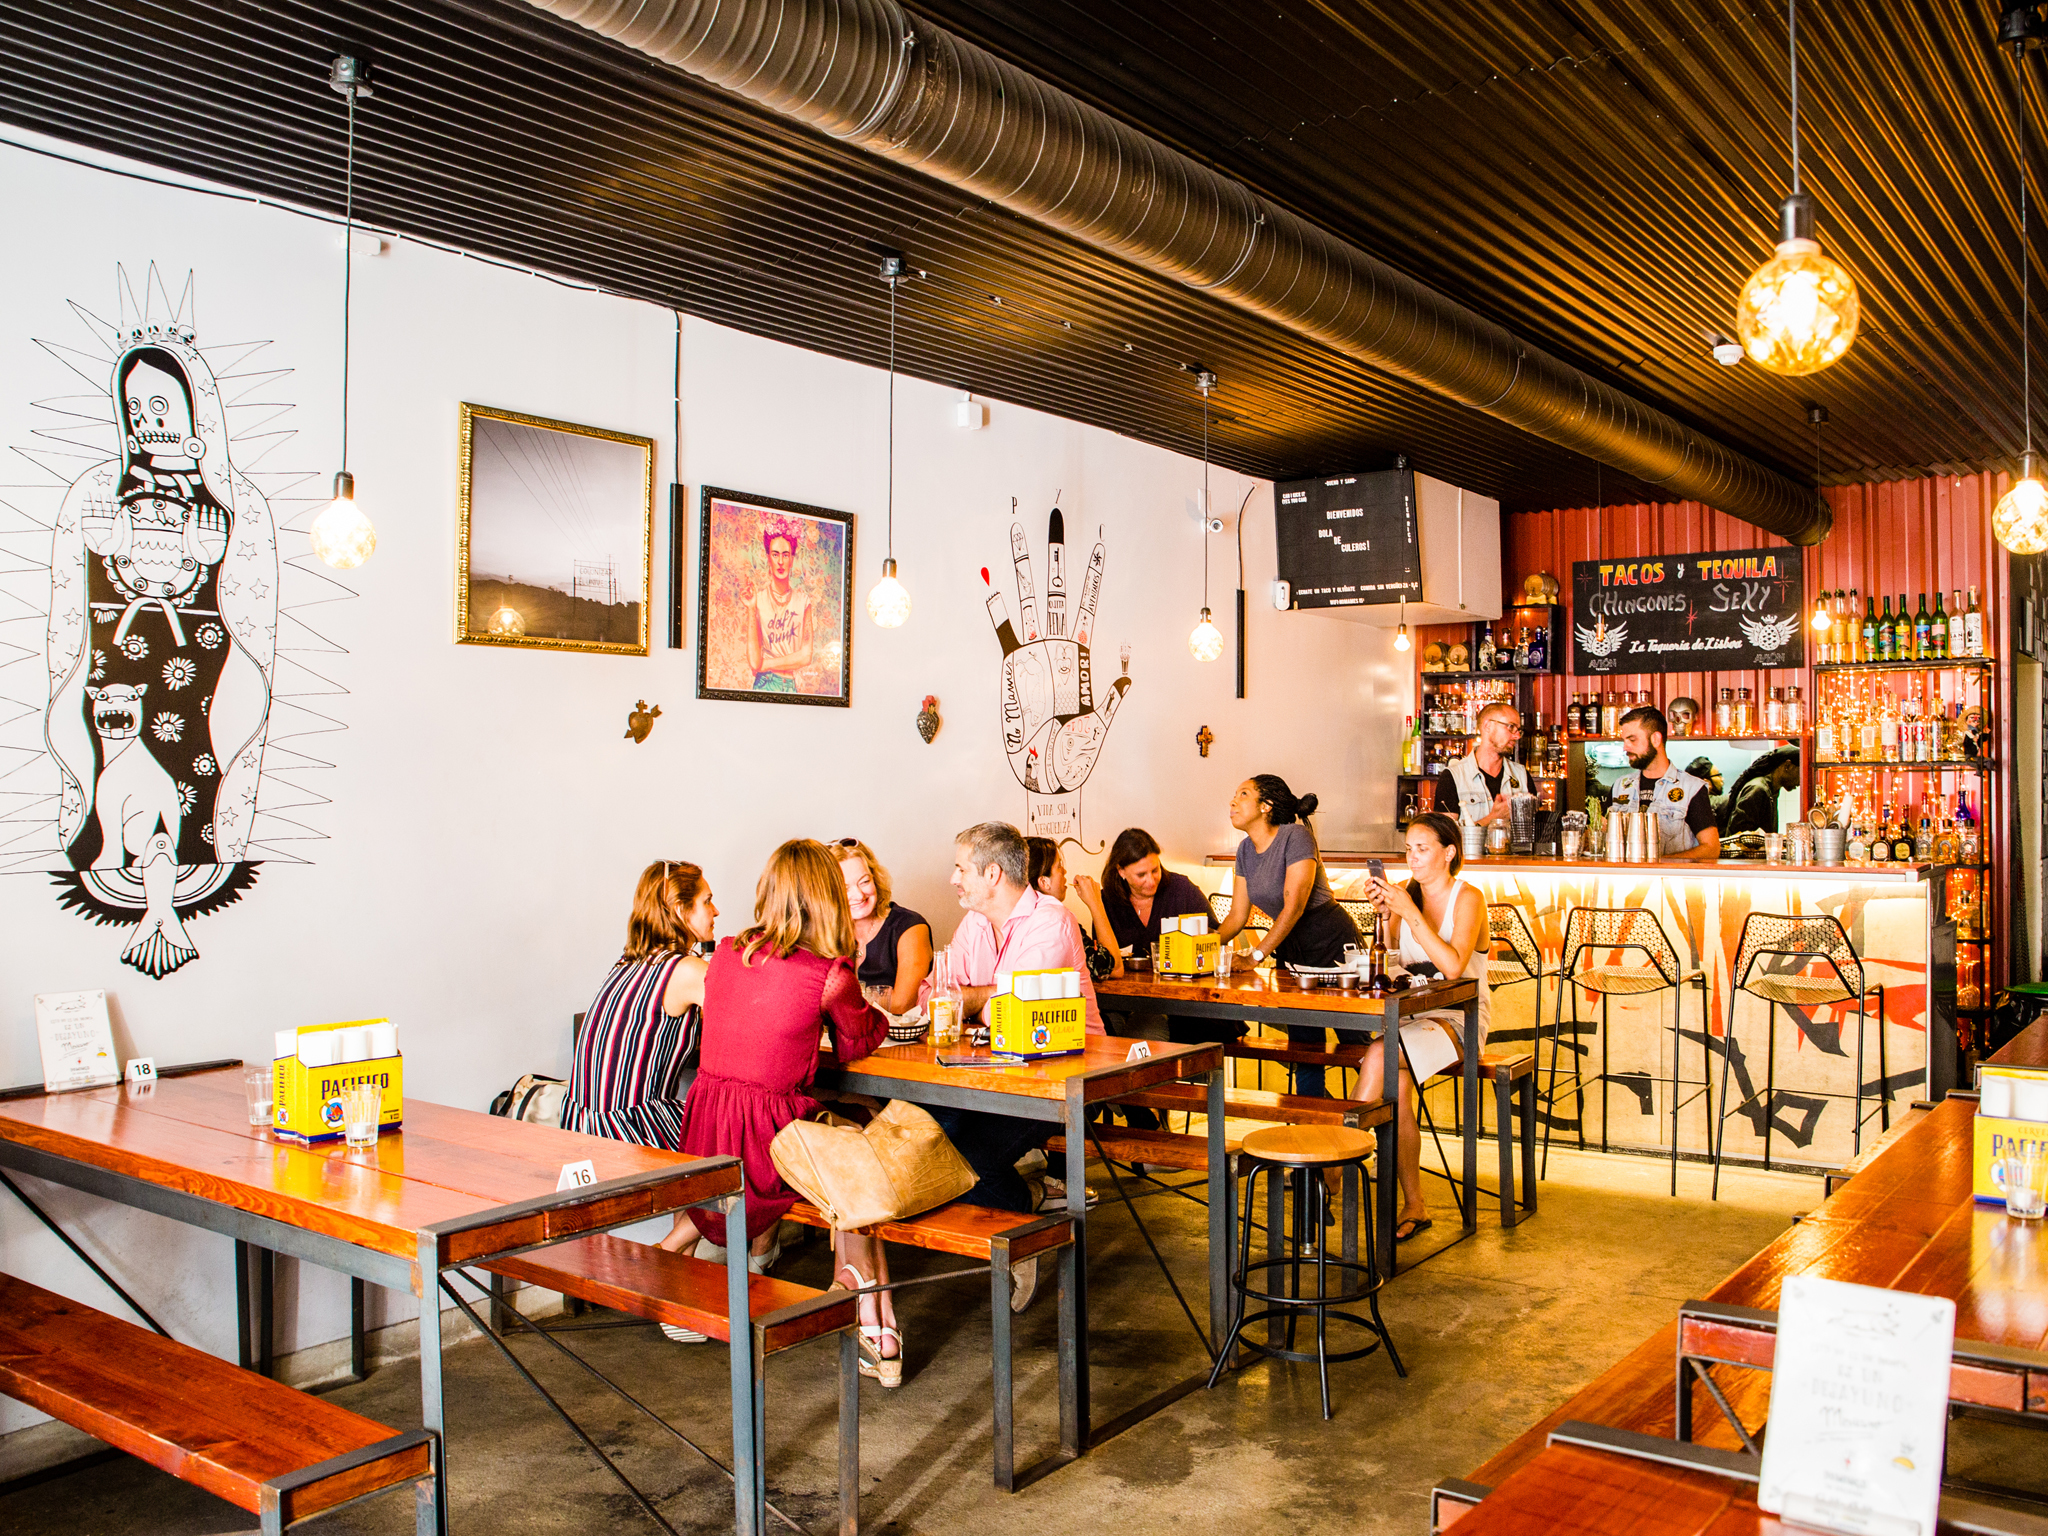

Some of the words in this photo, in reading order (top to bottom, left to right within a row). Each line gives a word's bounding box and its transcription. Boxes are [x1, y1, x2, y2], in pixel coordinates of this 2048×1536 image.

[1012, 496, 1018, 514] P
[1055, 488, 1062, 504] Y
[1326, 508, 1364, 520] BIENVENIDOS
[1318, 529, 1333, 538] BOLA
[1333, 536, 1342, 545] DE
[1600, 562, 1666, 586] TACOS
[1697, 556, 1777, 581] TEQUILA
[767, 609, 799, 631] daft
[1629, 640, 1646, 654] La
[1691, 638, 1704, 650] de
[1704, 636, 1743, 651] Lisboa
[1080, 652, 1091, 707] AMOR!
[1037, 804, 1053, 816] VIDA
[1057, 803, 1068, 815] SIN
[1031, 1009, 1077, 1027] PACIFICO
[134, 1063, 151, 1076] 18
[321, 1072, 389, 1100] PACIFICO
[573, 1168, 591, 1186] 16
